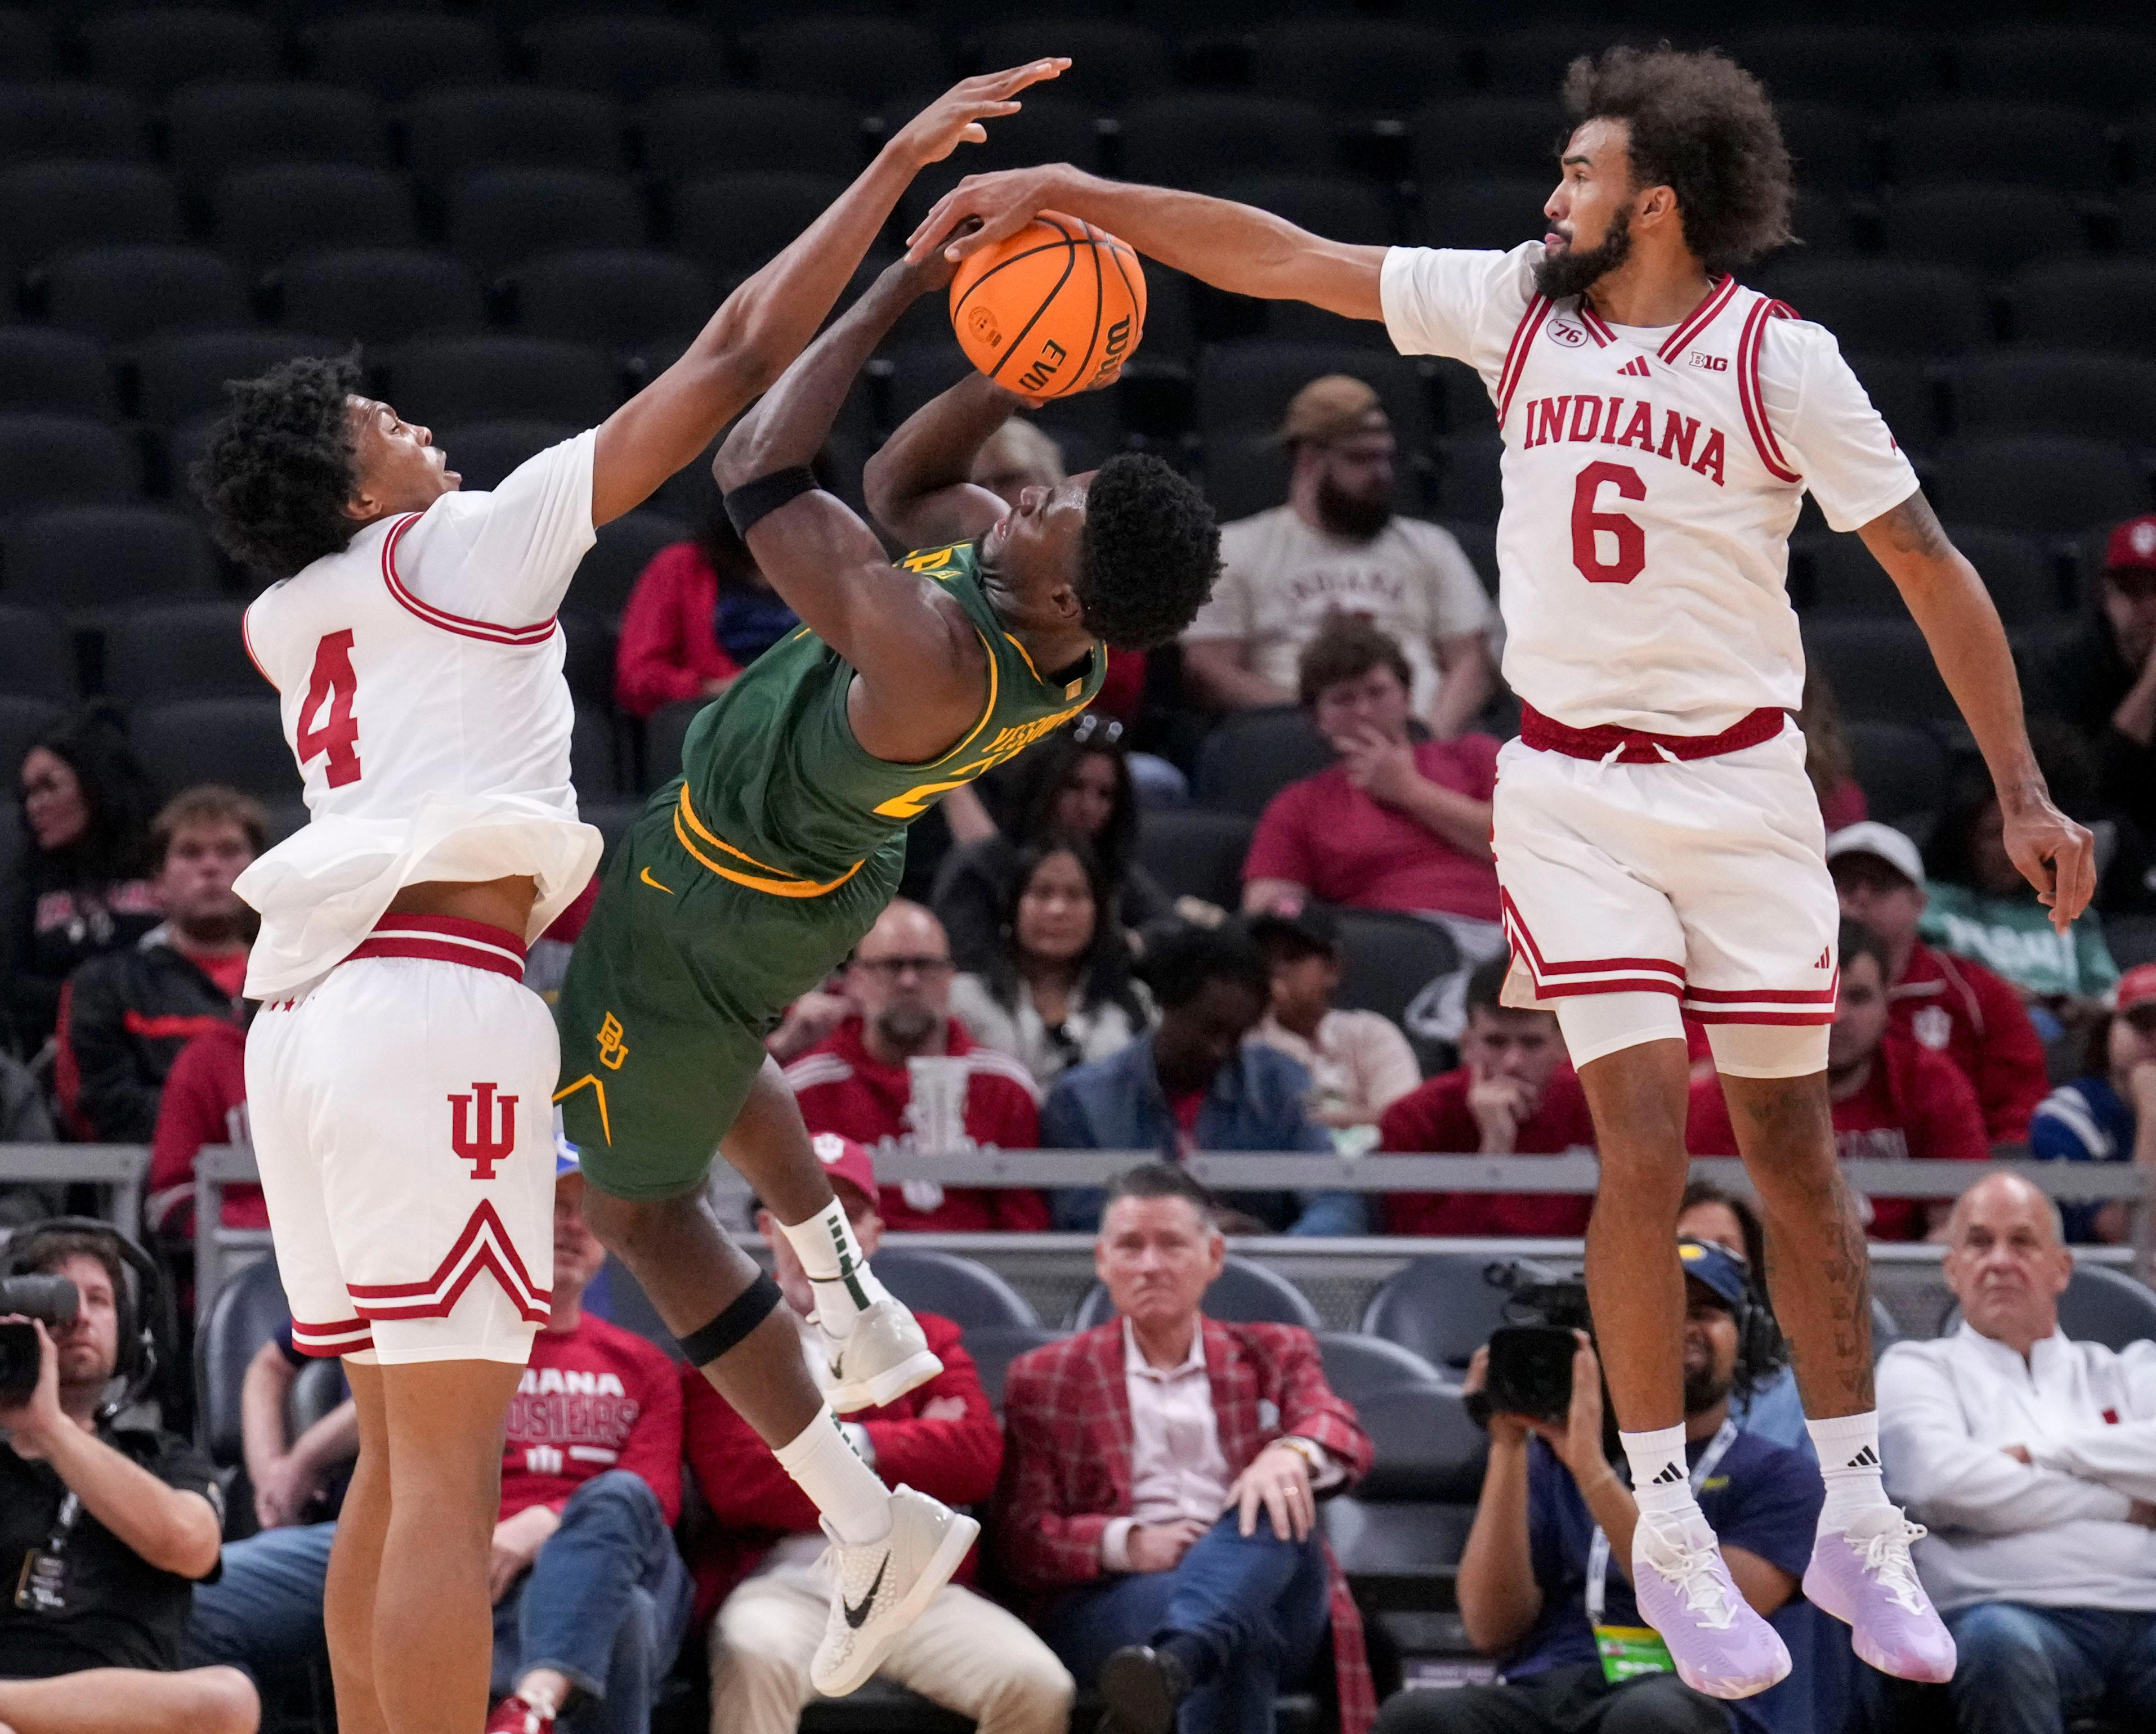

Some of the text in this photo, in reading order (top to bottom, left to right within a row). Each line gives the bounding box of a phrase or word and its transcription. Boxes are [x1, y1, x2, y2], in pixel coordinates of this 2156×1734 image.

[1524, 394, 1725, 487] INDIANA
[1571, 460, 1647, 585] 6
[297, 628, 362, 790] 4
[596, 1011, 629, 1070] BU
